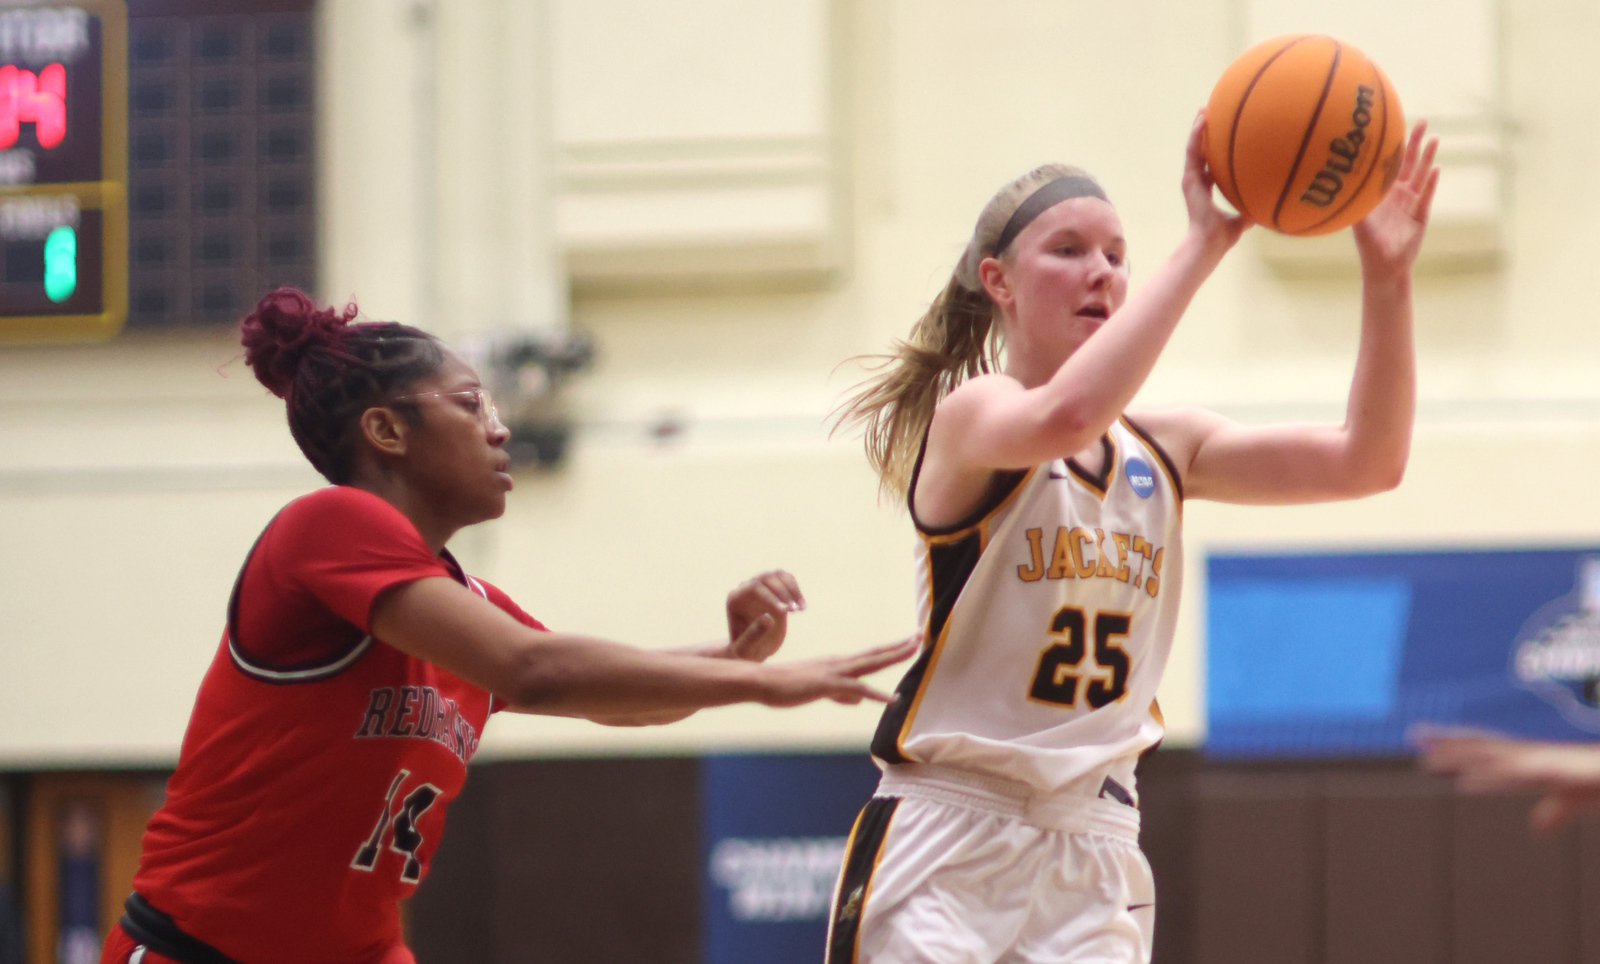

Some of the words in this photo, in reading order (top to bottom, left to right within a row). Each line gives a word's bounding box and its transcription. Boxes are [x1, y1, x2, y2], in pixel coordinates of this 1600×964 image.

[1300, 84, 1374, 206] Wilson
[1027, 604, 1134, 710] 25
[350, 768, 443, 884] 14
